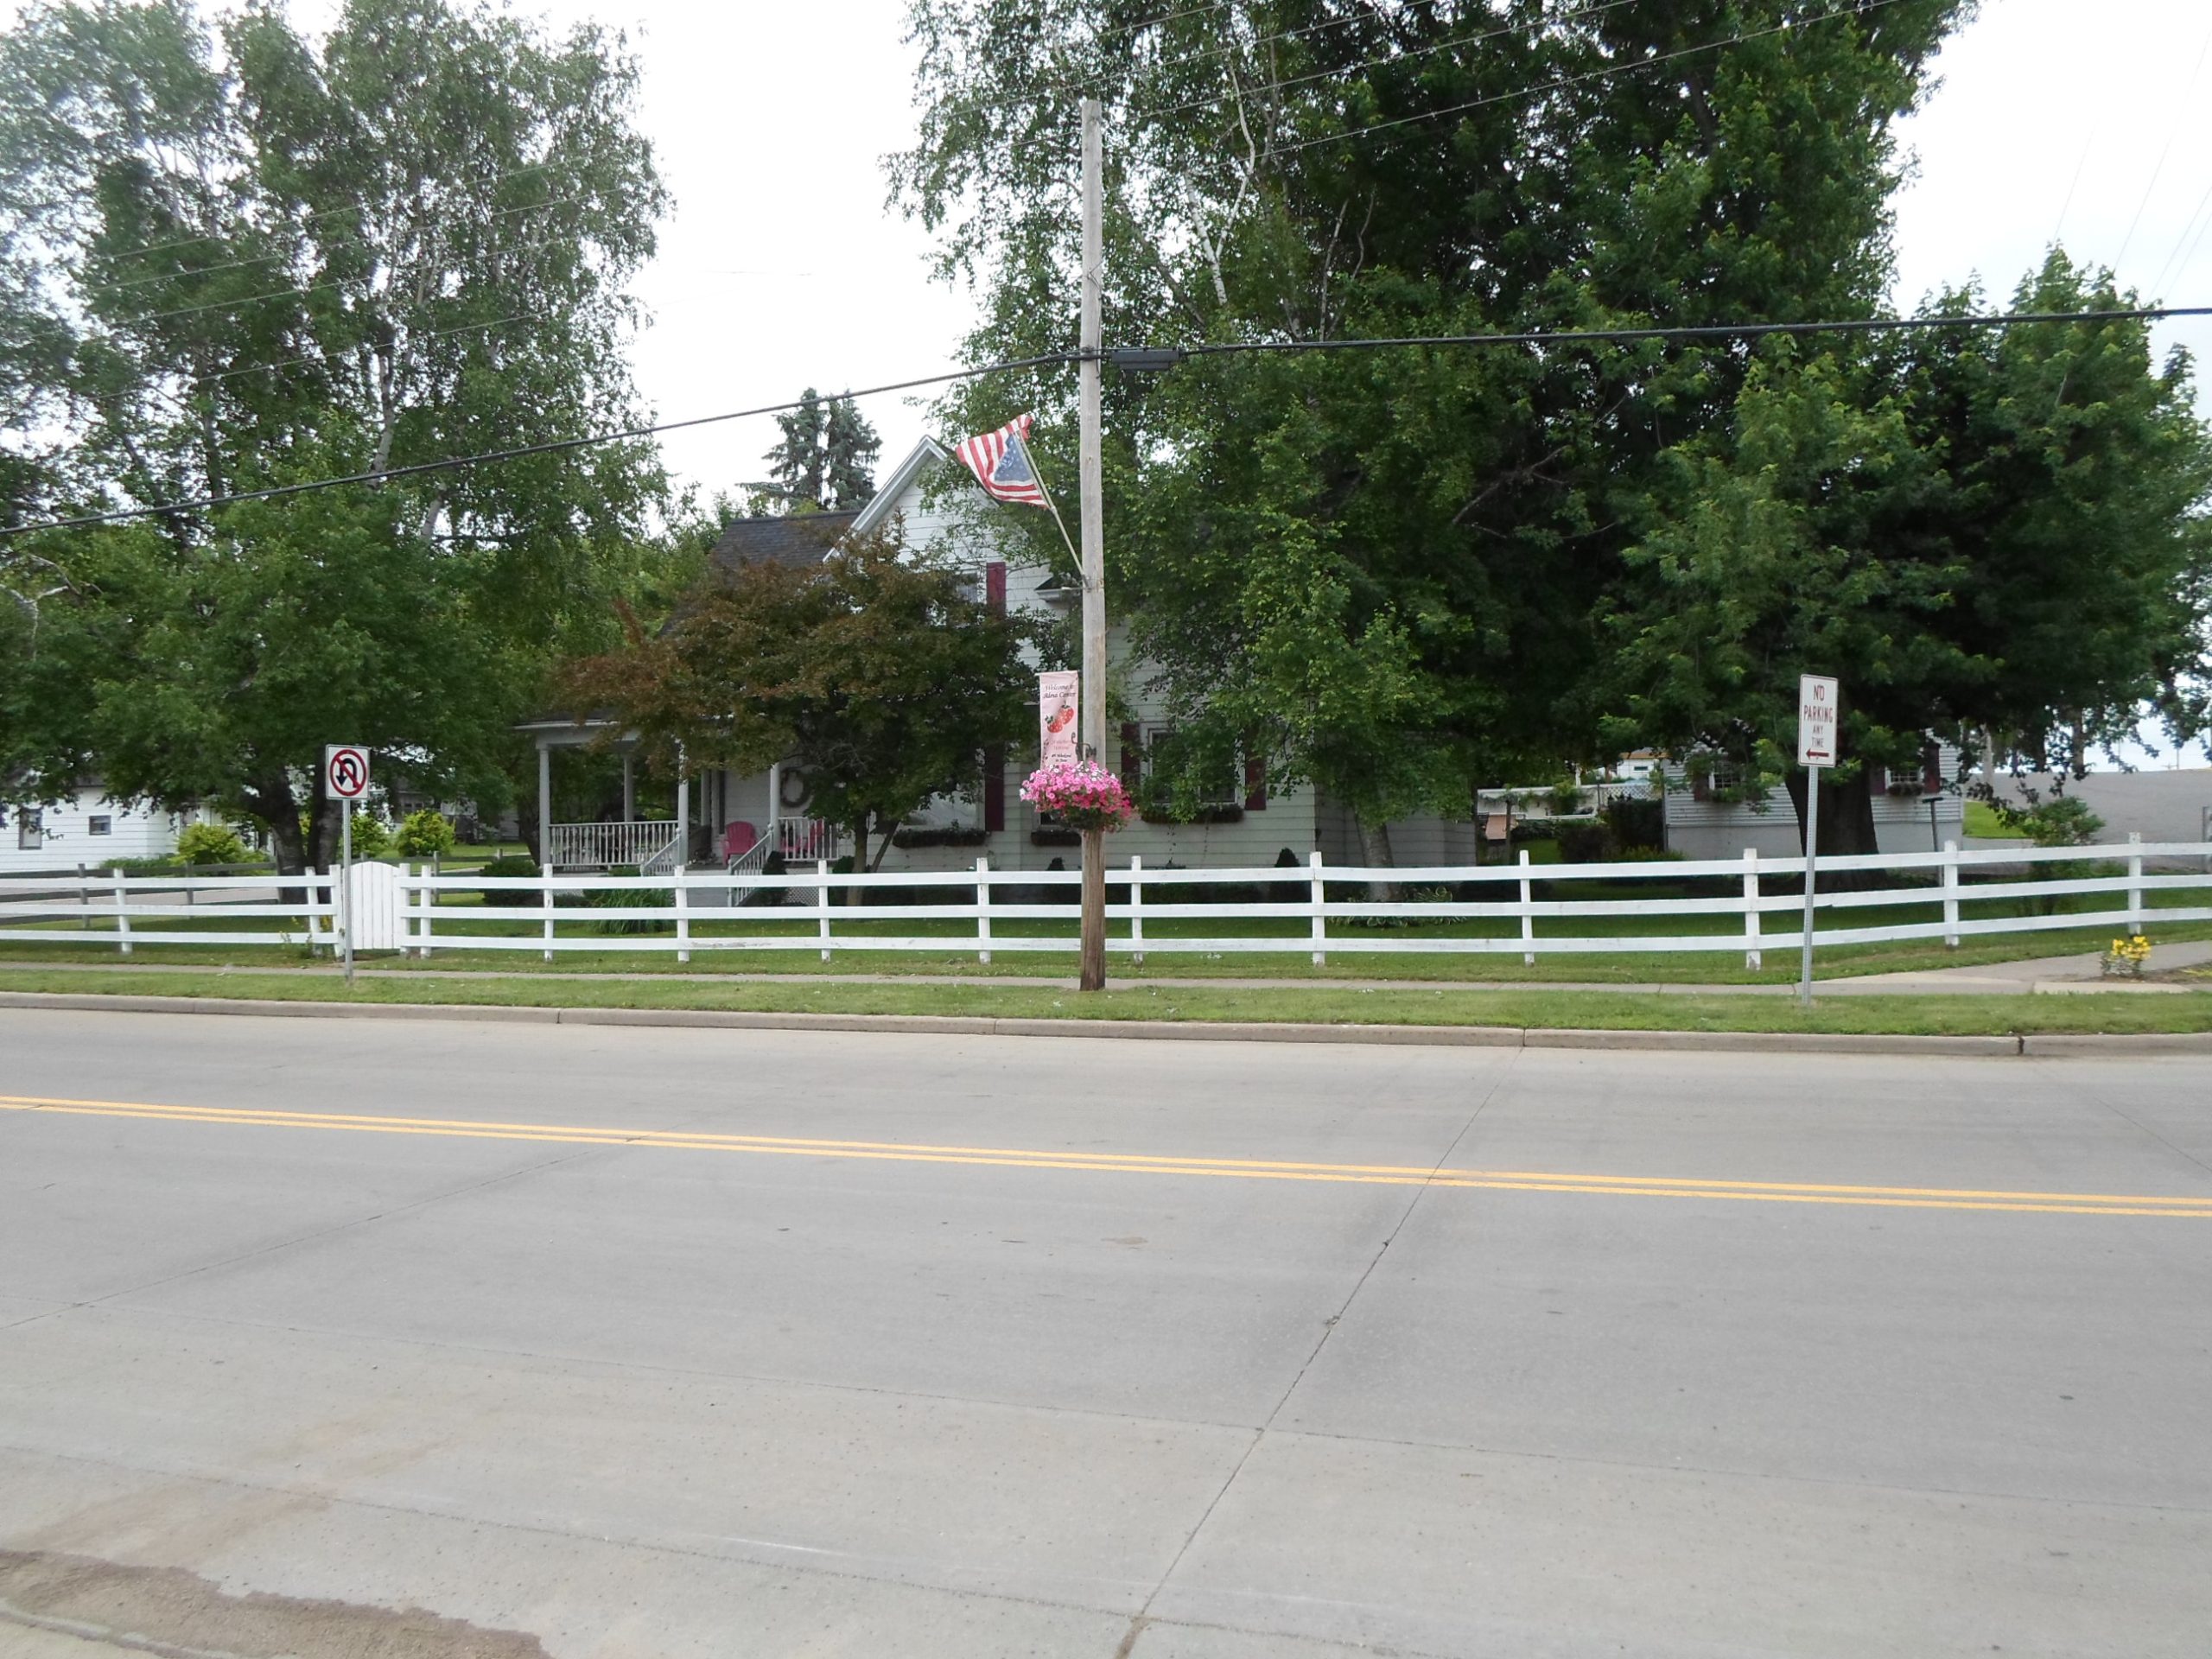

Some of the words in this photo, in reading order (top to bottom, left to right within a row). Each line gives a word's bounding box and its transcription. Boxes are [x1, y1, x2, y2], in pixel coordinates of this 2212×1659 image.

[1813, 684, 1826, 702] NO
[1803, 704, 1834, 724] PARKING
[1812, 725, 1824, 734] ANY
[1811, 736, 1824, 747] TIME
